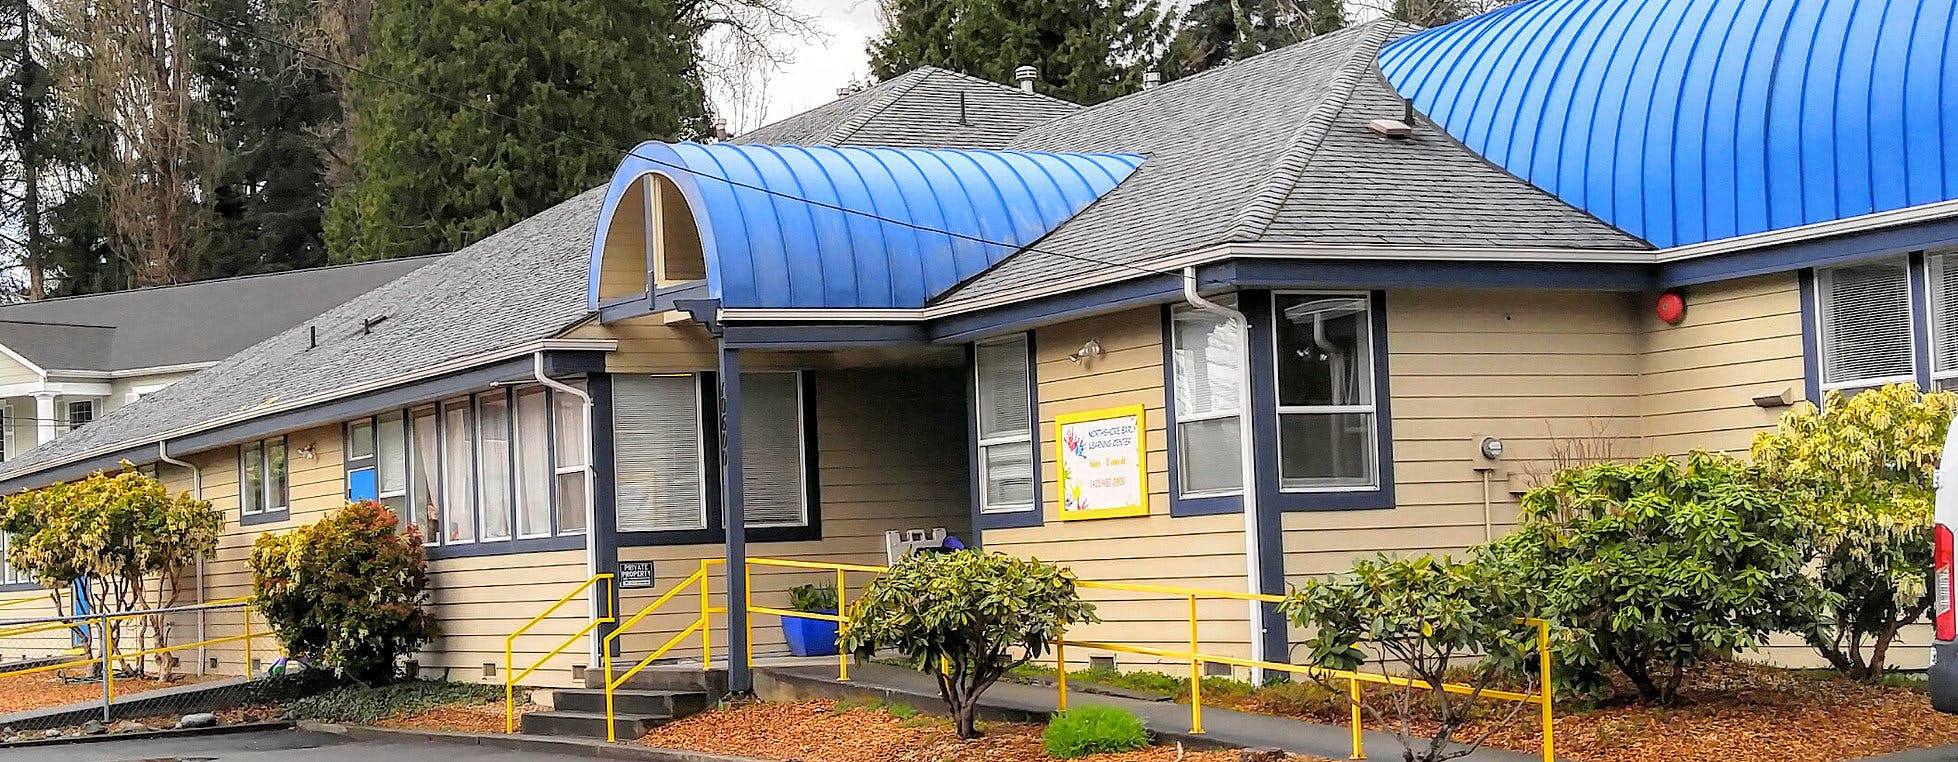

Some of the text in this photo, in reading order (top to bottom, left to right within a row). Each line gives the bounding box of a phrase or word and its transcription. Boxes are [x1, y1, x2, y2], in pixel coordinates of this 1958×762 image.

[1089, 427, 1120, 437] NORTHSHORE
[1089, 437, 1131, 449] LEARNING CENTER
[624, 563, 649, 571] PRIVATE
